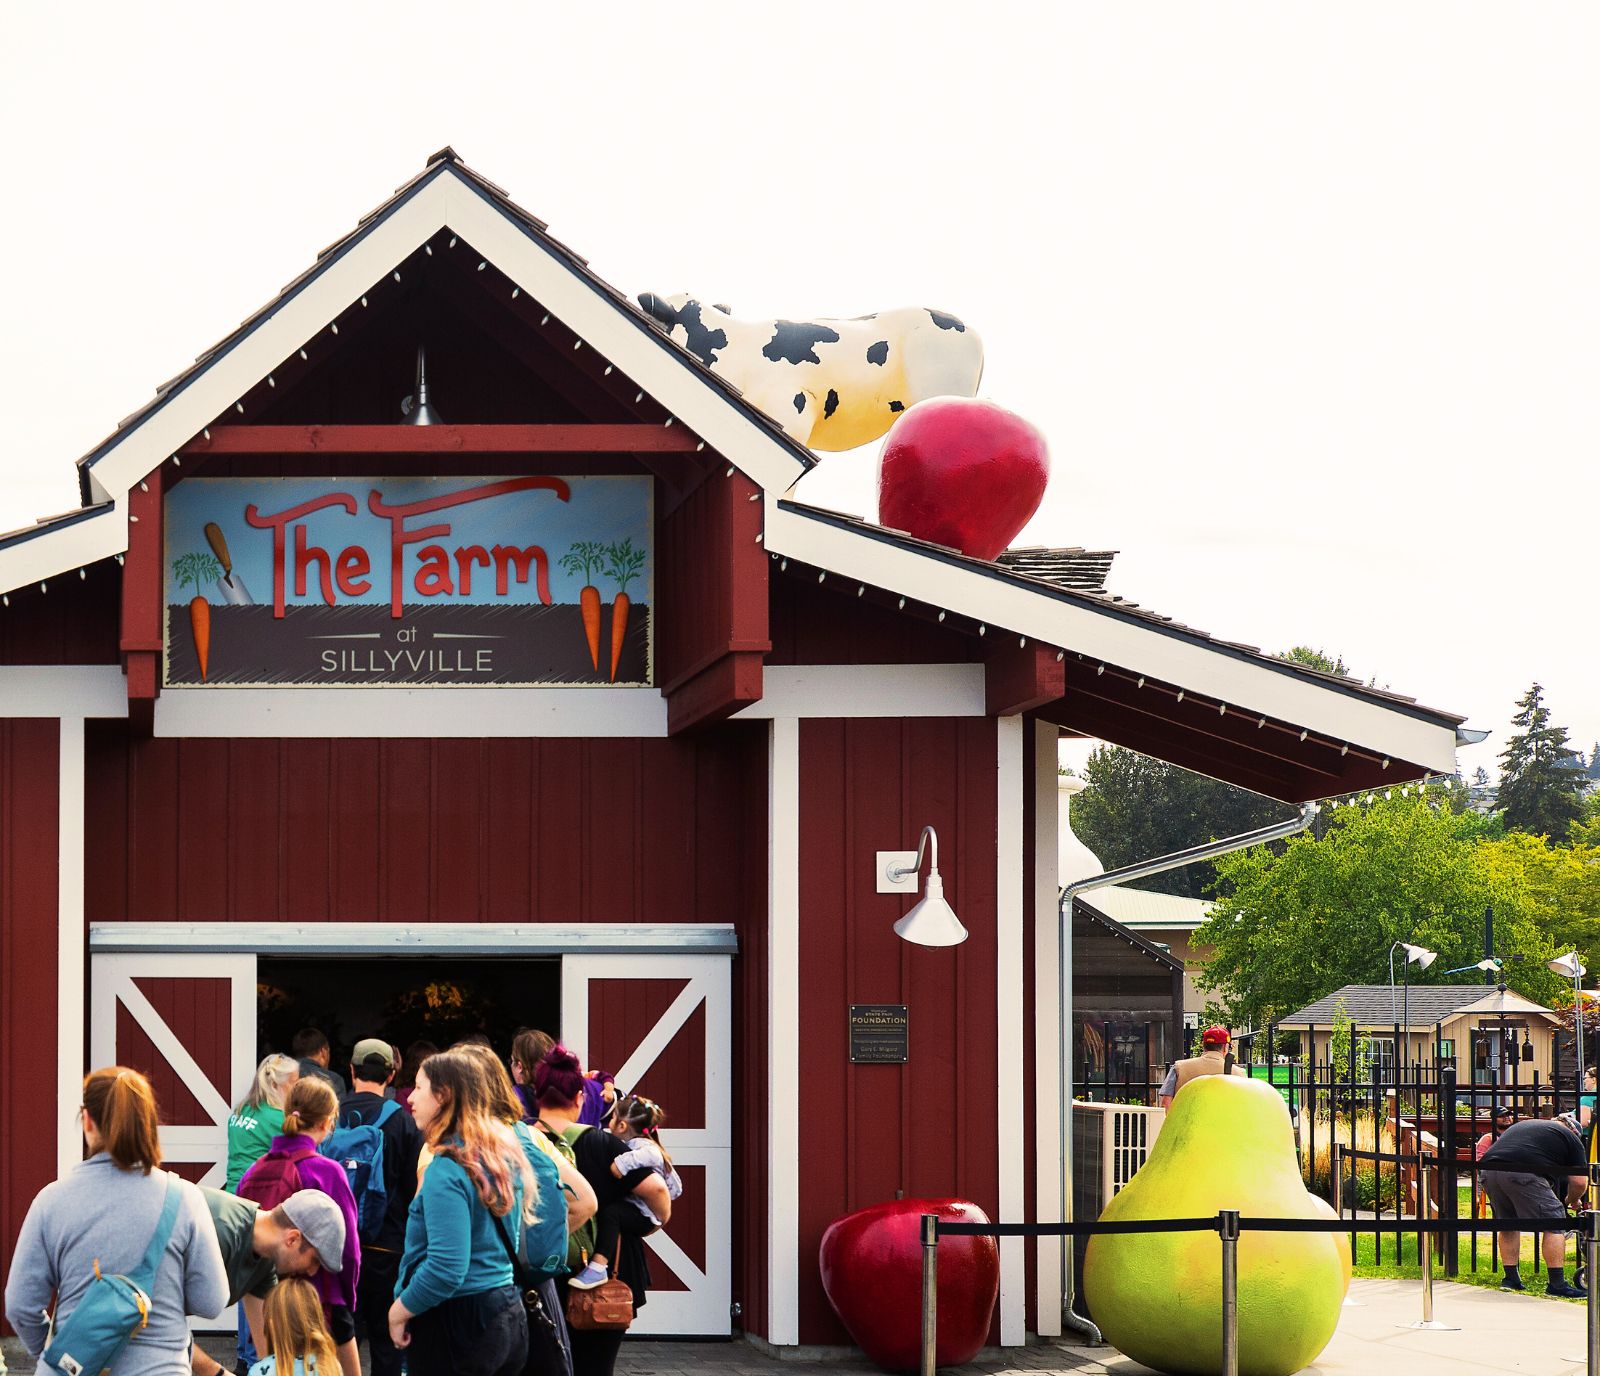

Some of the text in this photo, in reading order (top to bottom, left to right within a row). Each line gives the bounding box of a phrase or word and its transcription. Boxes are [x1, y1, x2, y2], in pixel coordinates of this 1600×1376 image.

[245, 476, 571, 620] The Farm
[396, 625, 418, 643] at
[320, 649, 493, 672] SILLYVILLE
